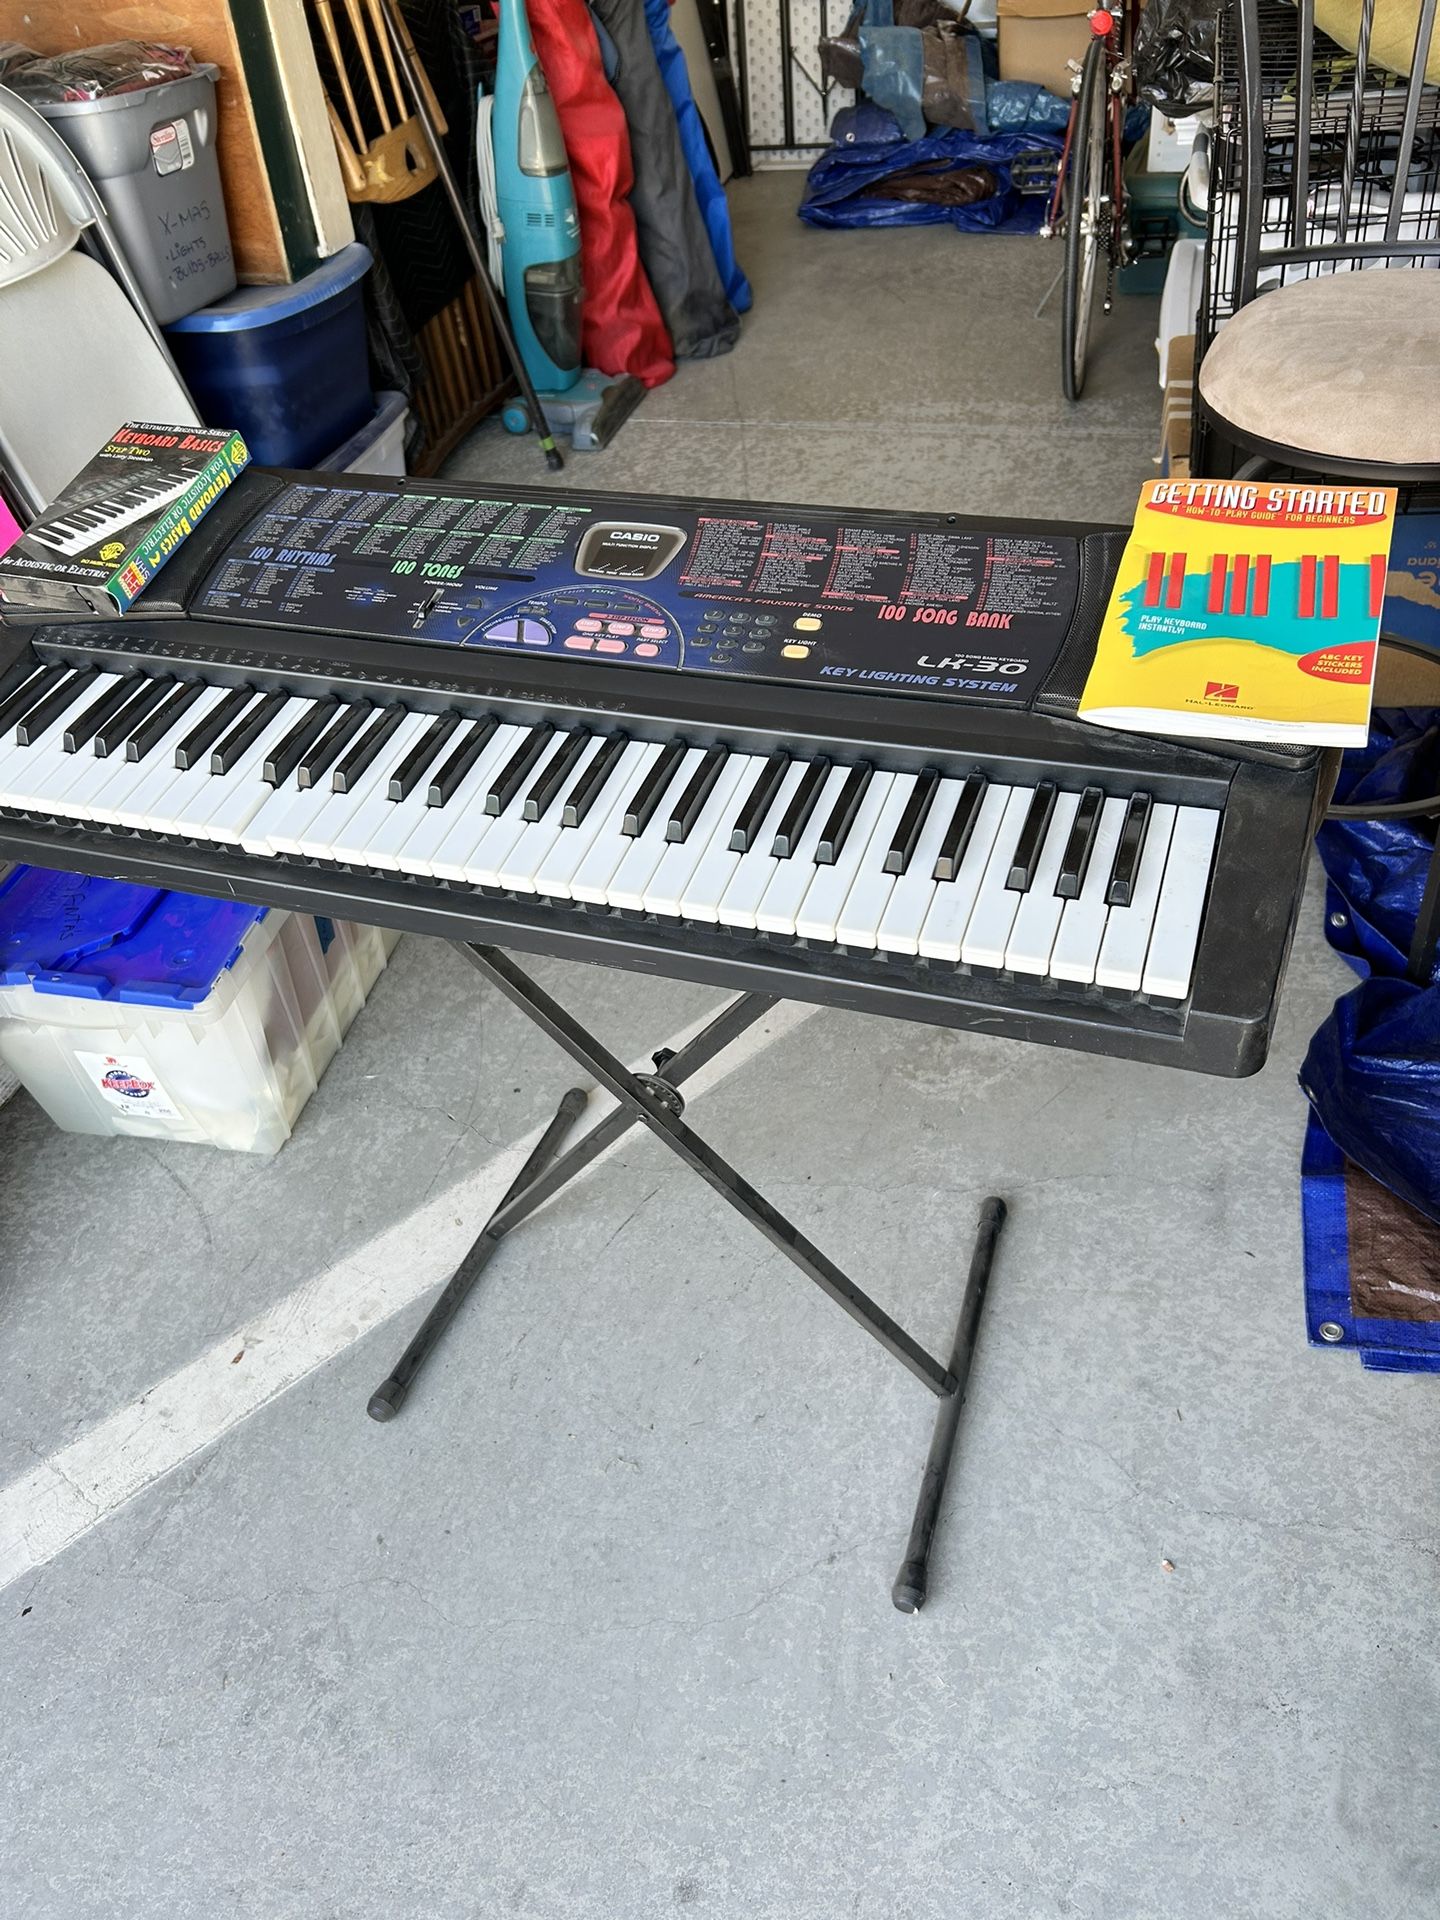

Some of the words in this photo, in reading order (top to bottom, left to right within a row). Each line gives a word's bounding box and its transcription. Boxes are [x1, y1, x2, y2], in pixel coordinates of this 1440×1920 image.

[140, 422, 172, 432] ULTIMATE
[112, 428, 180, 448] KEYBOARD
[178, 434, 226, 452] BASICS
[104, 444, 126, 454] STEP
[127, 446, 151, 456] TWO
[210, 457, 224, 474] FOR
[182, 473, 212, 508] ACOUSTIC
[189, 468, 232, 521] KEYBOARD
[1151, 482, 1258, 510] GETTING
[1266, 488, 1387, 516] STARTED
[172, 506, 184, 520] OR
[1285, 514, 1302, 522] FOR
[1306, 514, 1356, 524] BEGINNERS
[142, 519, 176, 555] ELECTRIC
[160, 516, 192, 555] BASICS
[610, 532, 660, 542] CASIO
[248, 546, 274, 560] 100
[275, 548, 338, 566] RHYTHMS
[11, 558, 54, 572] ACOUSTIC
[54, 564, 68, 572] OR
[66, 565, 110, 578] ELECTRIC
[136, 556, 150, 580] VHS
[391, 560, 417, 574] 100
[420, 562, 465, 578] TONES
[694, 592, 752, 603] AMERICA'S
[754, 598, 811, 608] FAVORITE
[814, 603, 854, 612] SONGS
[877, 604, 906, 620] 100
[912, 608, 958, 625] SONG
[965, 611, 1014, 629] BANK
[1140, 614, 1162, 624] PLAY
[1164, 617, 1208, 630] KEYBOARD
[1138, 622, 1185, 634] INSTANTLY!
[917, 655, 1028, 674] LK-30
[1312, 666, 1362, 675] INCLUDED
[1316, 660, 1363, 668] STICKERS
[819, 666, 857, 676] KEY
[859, 670, 938, 686] LIGHTING
[942, 678, 1018, 693] SYSTEM
